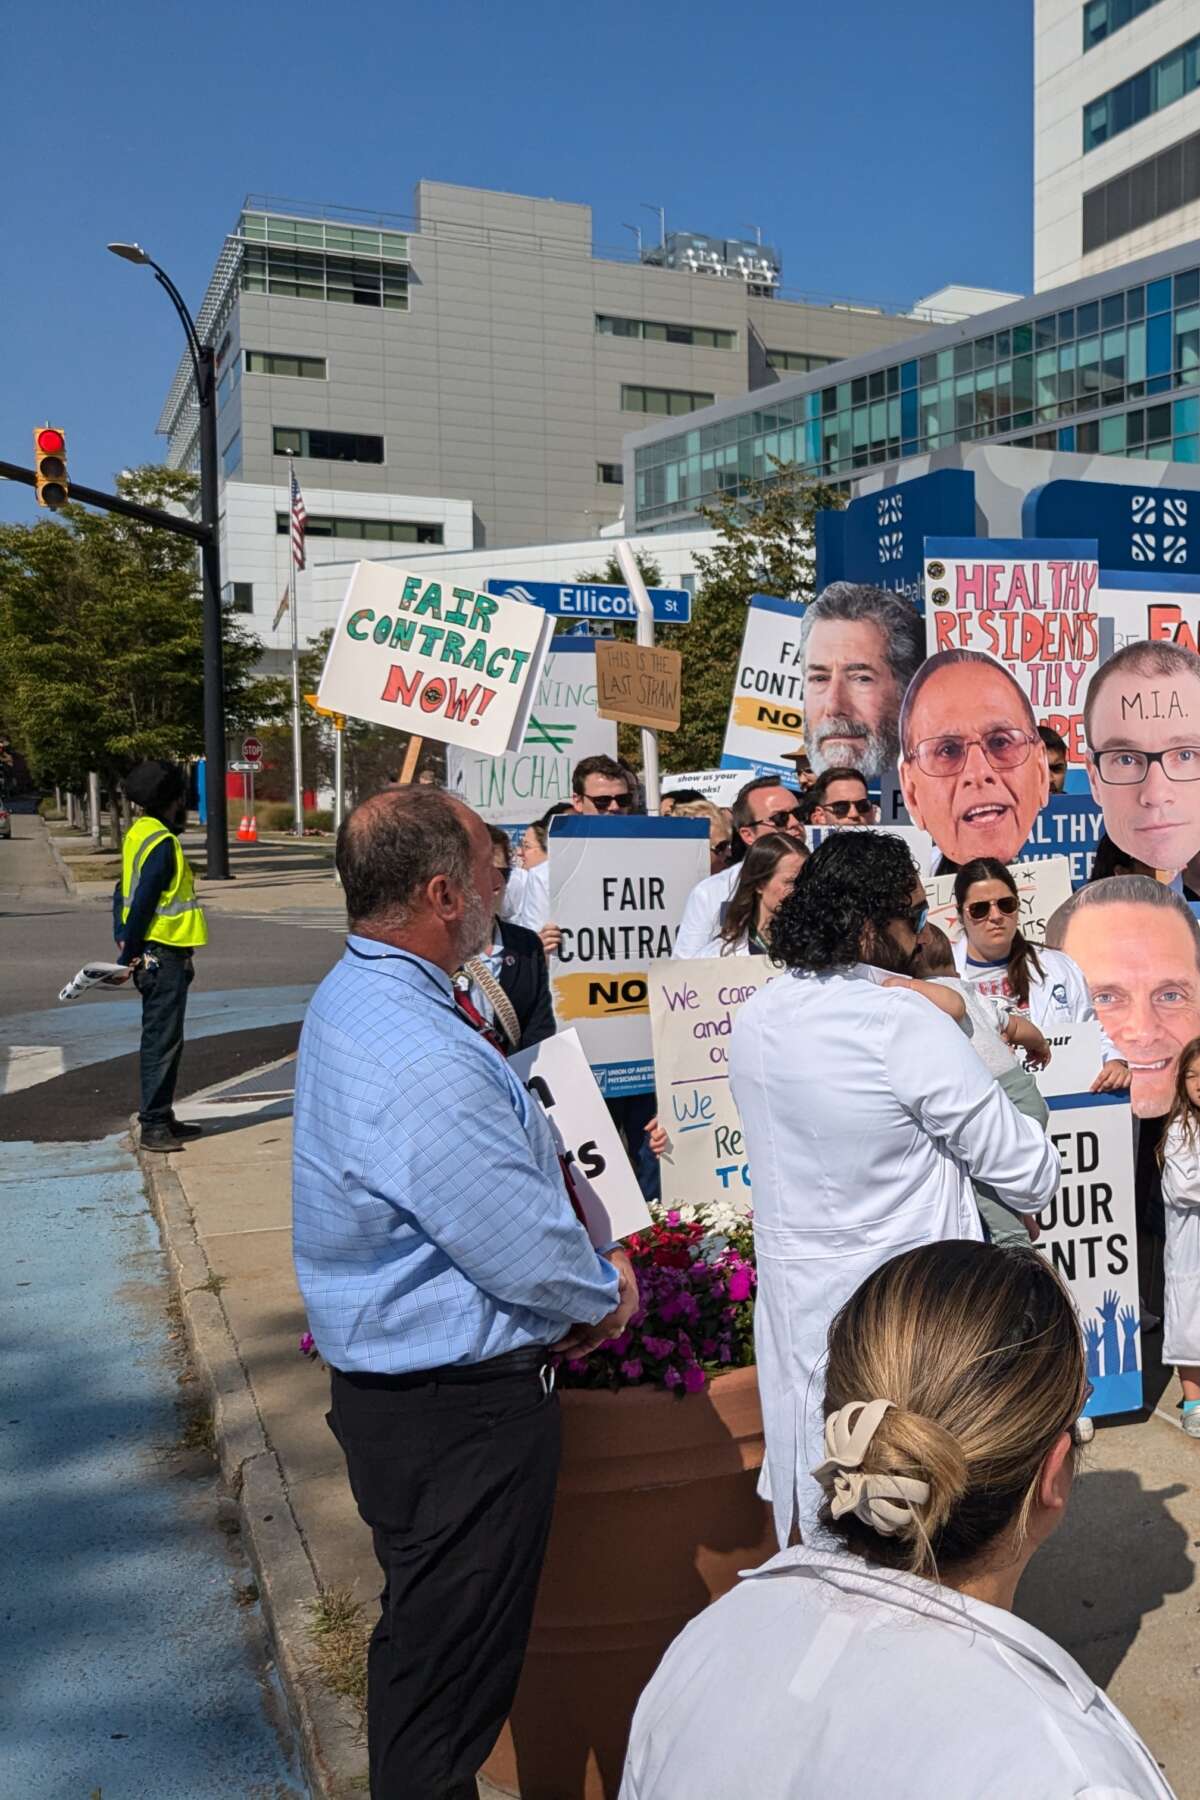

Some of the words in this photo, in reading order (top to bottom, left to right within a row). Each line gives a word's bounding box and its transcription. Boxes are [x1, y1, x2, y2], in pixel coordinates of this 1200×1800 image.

[559, 588, 638, 615] Ellicot
[664, 600, 679, 612] St
[955, 562, 1097, 611] HEALTHY
[398, 575, 500, 633] FAIR
[346, 608, 531, 684] CONTRACT
[607, 650, 631, 670] THIS
[636, 652, 646, 671] IS
[651, 653, 673, 675] THE
[381, 664, 497, 727] NOW!
[601, 671, 632, 700] LAST
[636, 673, 679, 710] STRAW
[740, 666, 805, 701] CONT
[757, 706, 802, 729] NO
[1121, 690, 1189, 721] M.I.A.
[244, 745, 262, 756] STOP
[475, 758, 506, 808] IN
[511, 755, 573, 799] CHAI
[714, 773, 738, 782] your
[602, 877, 665, 912] FAIR
[558, 925, 680, 963] CONTRA
[588, 980, 648, 1005] NO
[662, 982, 700, 1012] We
[718, 985, 757, 1006] care
[693, 1011, 732, 1039] and
[672, 1089, 716, 1122] We
